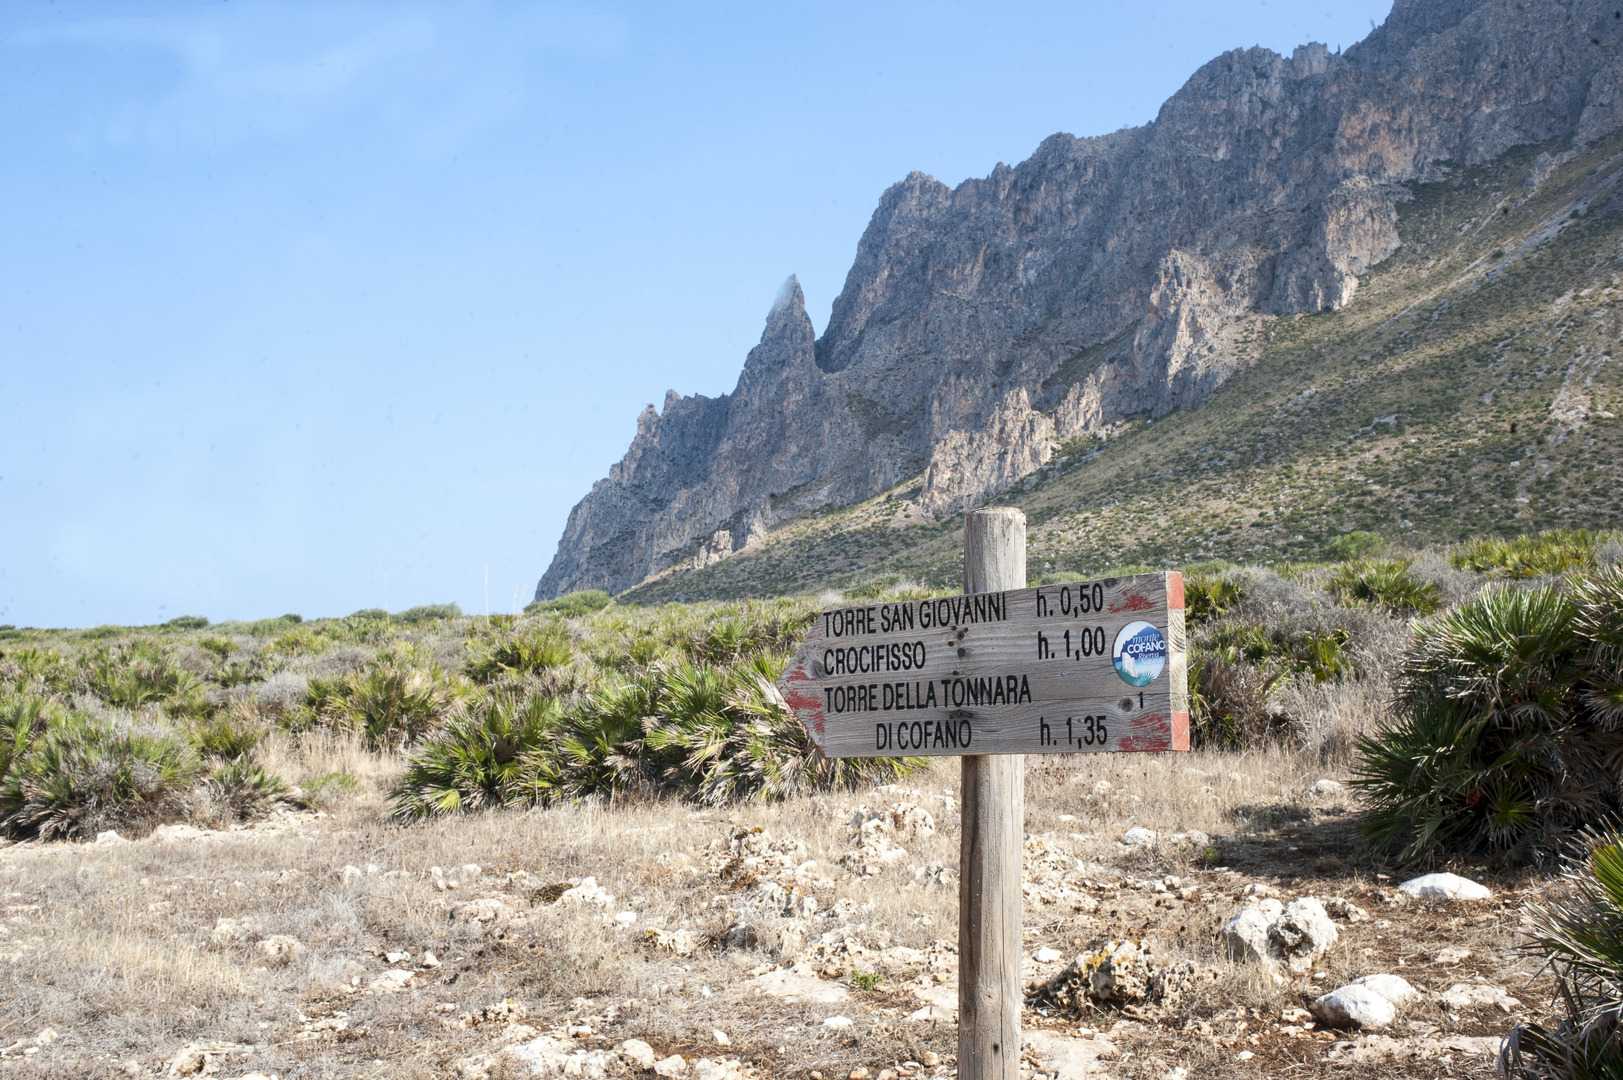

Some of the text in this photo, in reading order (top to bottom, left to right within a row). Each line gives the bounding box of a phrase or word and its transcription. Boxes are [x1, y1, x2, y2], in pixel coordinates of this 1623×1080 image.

[823, 592, 1007, 638] TORRE SAN GIOVANNI
[1036, 583, 1104, 619] h. 0,50
[1037, 626, 1106, 662] h. 1,00
[1127, 640, 1166, 654] COFANO
[1132, 633, 1160, 644] monte
[823, 640, 926, 676] CROCIFISSO
[824, 674, 1032, 714] TORRE DELLA TONNARA
[1137, 691, 1144, 709] 1
[876, 719, 972, 750] DI COFANO
[1040, 715, 1108, 750] h. 1,35
